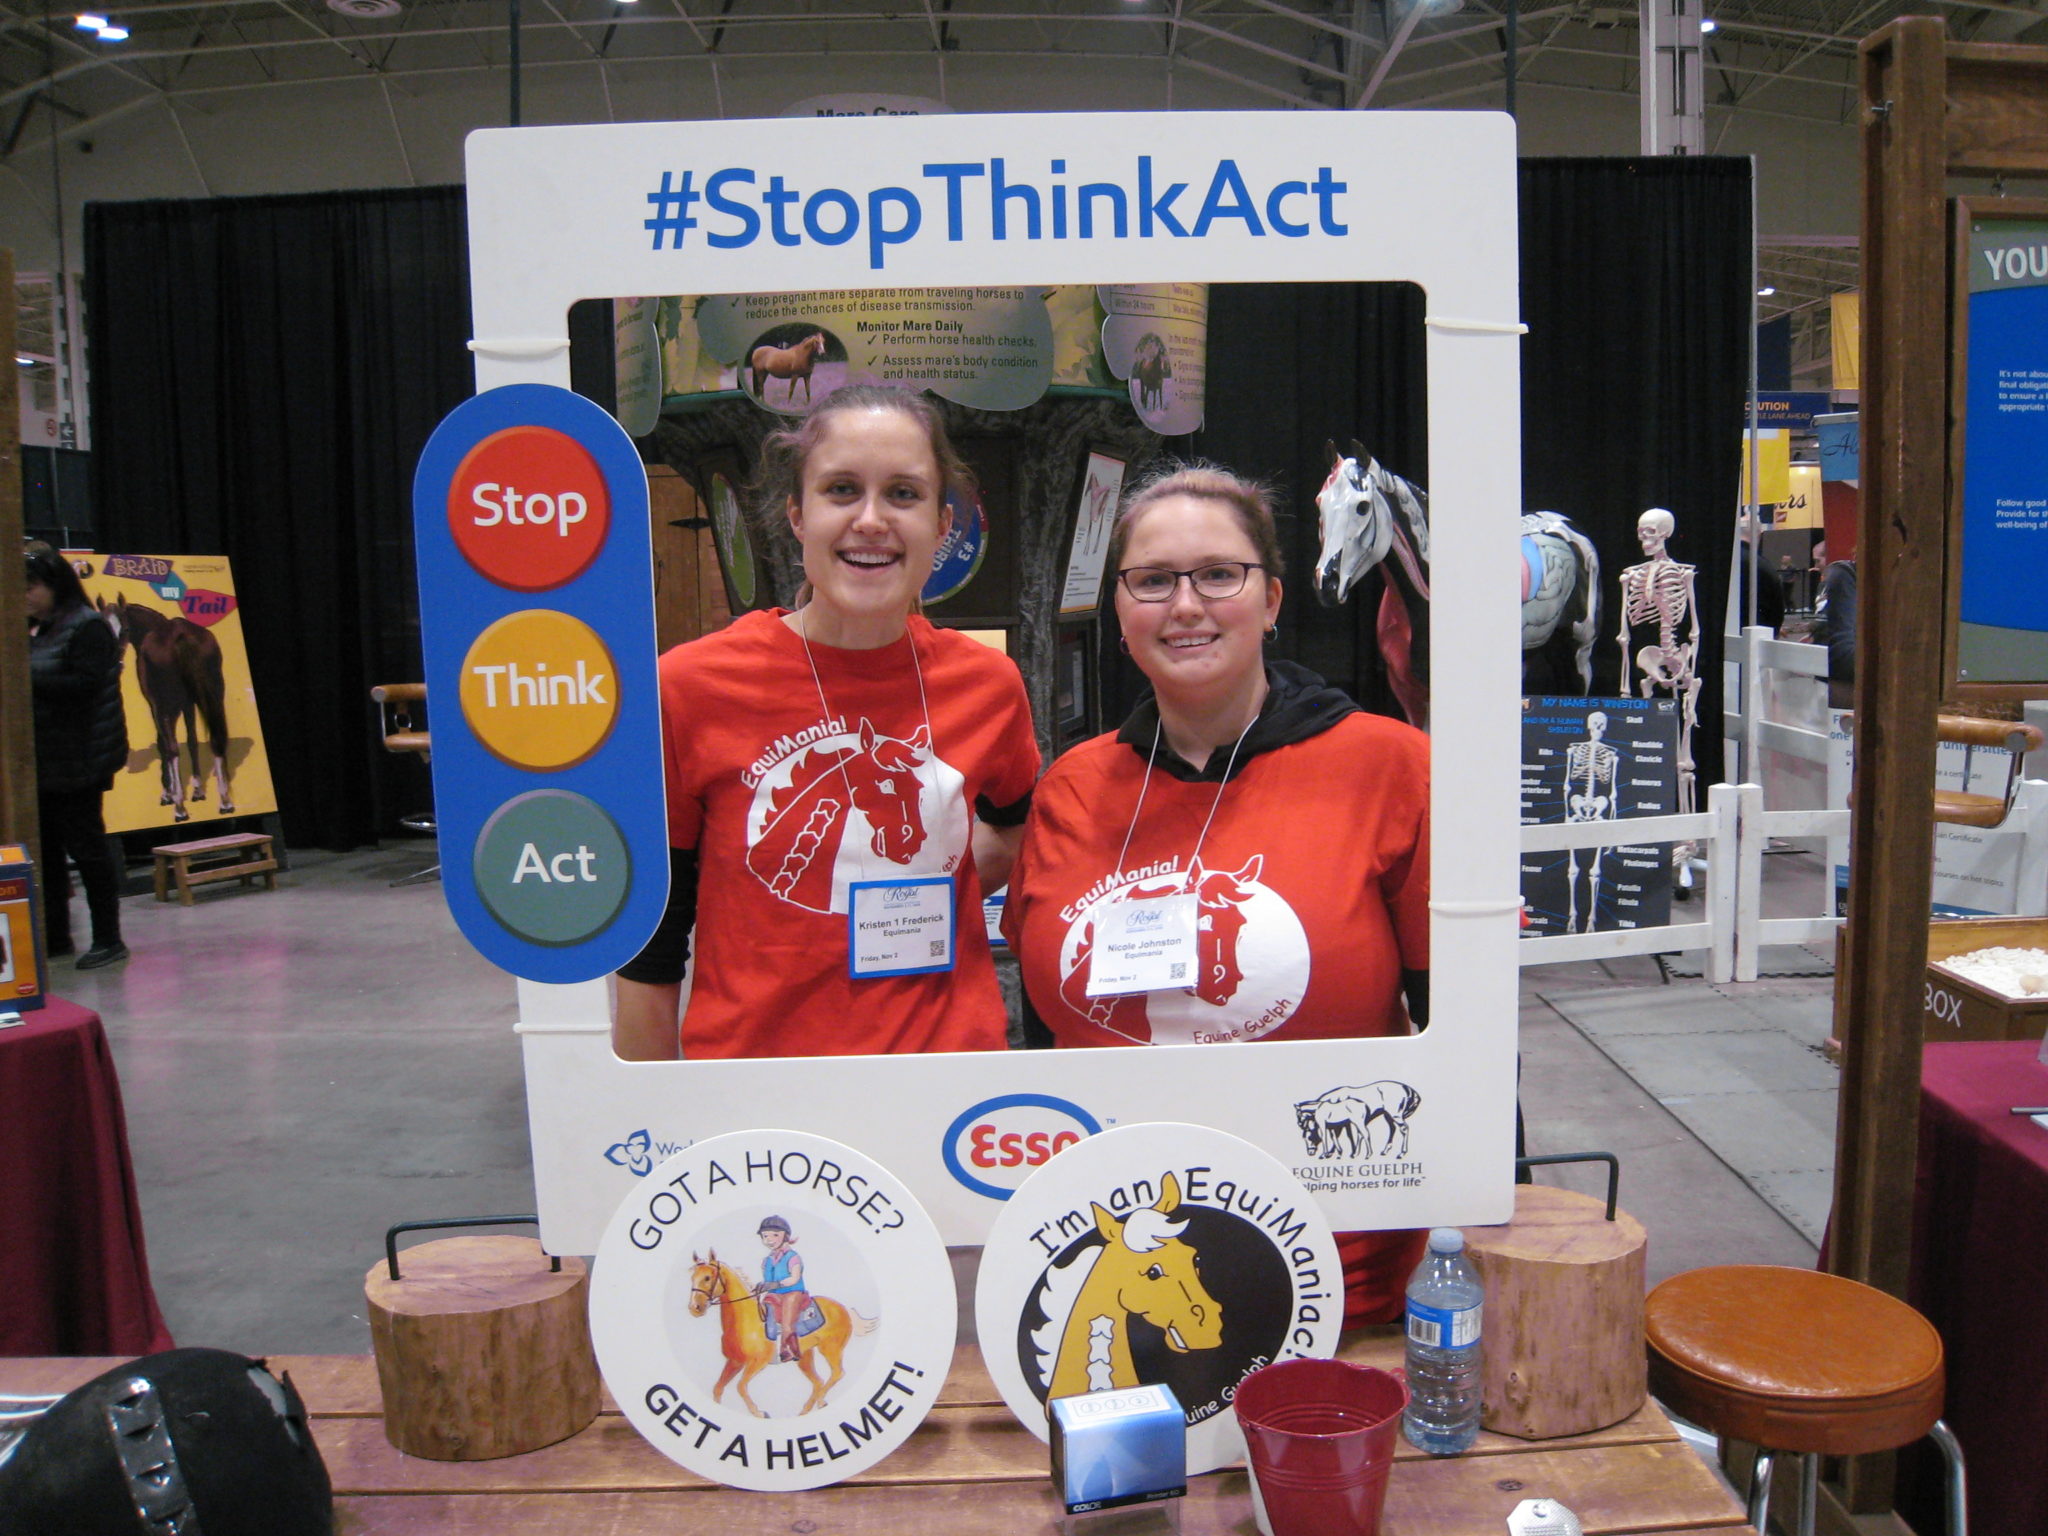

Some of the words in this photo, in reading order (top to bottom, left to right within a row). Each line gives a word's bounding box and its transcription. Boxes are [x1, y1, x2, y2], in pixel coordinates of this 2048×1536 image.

[643, 155, 1350, 270] #StopThinkAct
[1984, 246, 2048, 281] YOU
[746, 295, 770, 307] Keep
[772, 292, 817, 305] pregnant
[819, 290, 846, 300] mare
[848, 288, 896, 300] separate
[899, 288, 924, 298] from
[926, 287, 974, 300] traveling
[976, 287, 1012, 300] horses
[1013, 290, 1024, 300] to
[746, 307, 780, 320] reduce
[781, 305, 798, 317] the
[800, 302, 844, 315] chances
[846, 301, 858, 312] of
[860, 300, 901, 312] disease
[904, 299, 976, 312] transmission.
[856, 320, 900, 333] Monitor
[903, 320, 932, 332] Mare
[935, 320, 963, 334] Daily
[883, 333, 926, 345] Perform
[929, 333, 960, 345] horse
[962, 334, 995, 346] health
[883, 354, 922, 366] Assess
[925, 354, 960, 366] mare's
[963, 354, 989, 369] body
[991, 355, 1038, 368] condition
[883, 368, 903, 379] and
[906, 367, 940, 379] health
[943, 368, 979, 379] status.
[1744, 401, 1790, 411] CUTION
[472, 482, 588, 537] Stop
[113, 558, 169, 577] BRAID
[161, 586, 180, 599] my
[185, 596, 228, 615] Tail
[473, 659, 607, 709] Think
[741, 715, 848, 790] EquiMania!
[511, 842, 598, 885] Act
[1058, 854, 1180, 924] EquiMania!
[859, 920, 892, 931] Kristen
[895, 916, 899, 926] 1
[902, 913, 944, 926] Frederick
[883, 927, 921, 938] Equimania
[1107, 943, 1136, 952] Nicole
[1138, 937, 1182, 950] Johnston
[1193, 1028, 1240, 1045] Equine
[1243, 996, 1292, 1034] Guelph
[1292, 1165, 1354, 1182] EQUINE
[1358, 1162, 1423, 1176] GUELPH
[1340, 1178, 1379, 1190] horses
[1382, 1177, 1399, 1188] for
[629, 1171, 699, 1251] GOT
[707, 1159, 737, 1195] A
[745, 1150, 905, 1235] HORSE?
[1029, 1208, 1089, 1259] I'm
[1109, 1179, 1154, 1211] an
[643, 1383, 723, 1450] GET
[719, 1433, 750, 1468] A
[765, 1360, 925, 1470] HELMET!
[1184, 1400, 1220, 1424] uine
